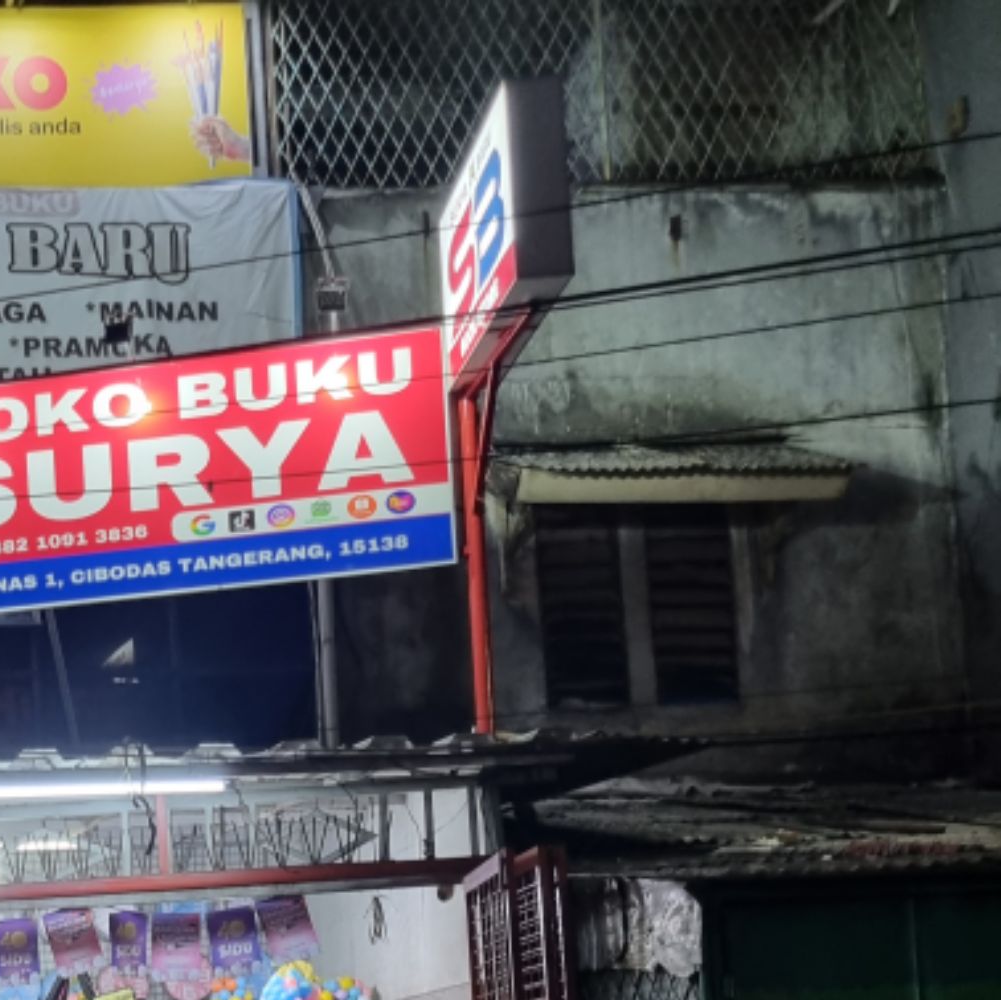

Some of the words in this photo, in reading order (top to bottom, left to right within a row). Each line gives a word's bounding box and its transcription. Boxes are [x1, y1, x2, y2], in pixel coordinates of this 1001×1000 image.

[29, 118, 81, 135] anda
[6, 222, 191, 286] BARU
[177, 347, 412, 420] BUKU
[38, 534, 87, 550] 1091
[46, 573, 63, 588] 1,
[71, 560, 171, 584] CIBODAS
[178, 545, 332, 572] TANGERANG,
[339, 535, 409, 556] 15138
[220, 943, 253, 959] SIDU
